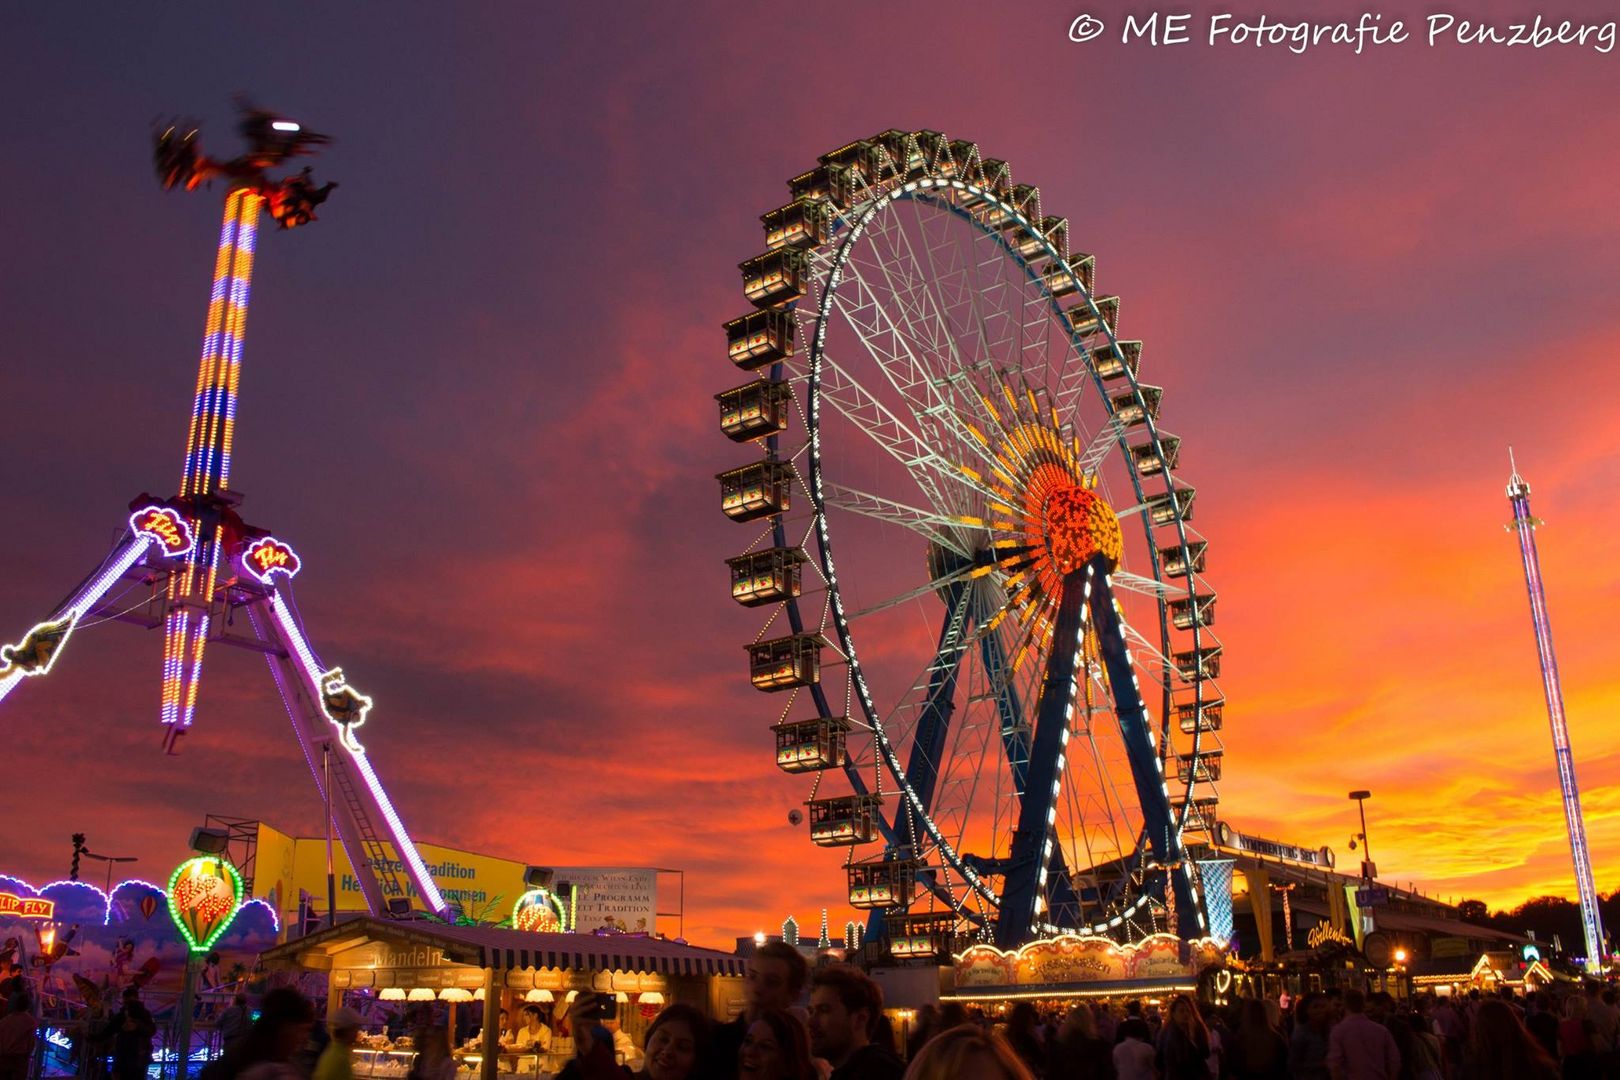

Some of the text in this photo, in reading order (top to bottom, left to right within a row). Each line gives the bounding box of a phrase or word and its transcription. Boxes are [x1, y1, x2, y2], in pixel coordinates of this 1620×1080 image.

[421, 860, 476, 879] radition
[0, 896, 48, 914] LIP FLY
[374, 946, 442, 967] Mandeln
